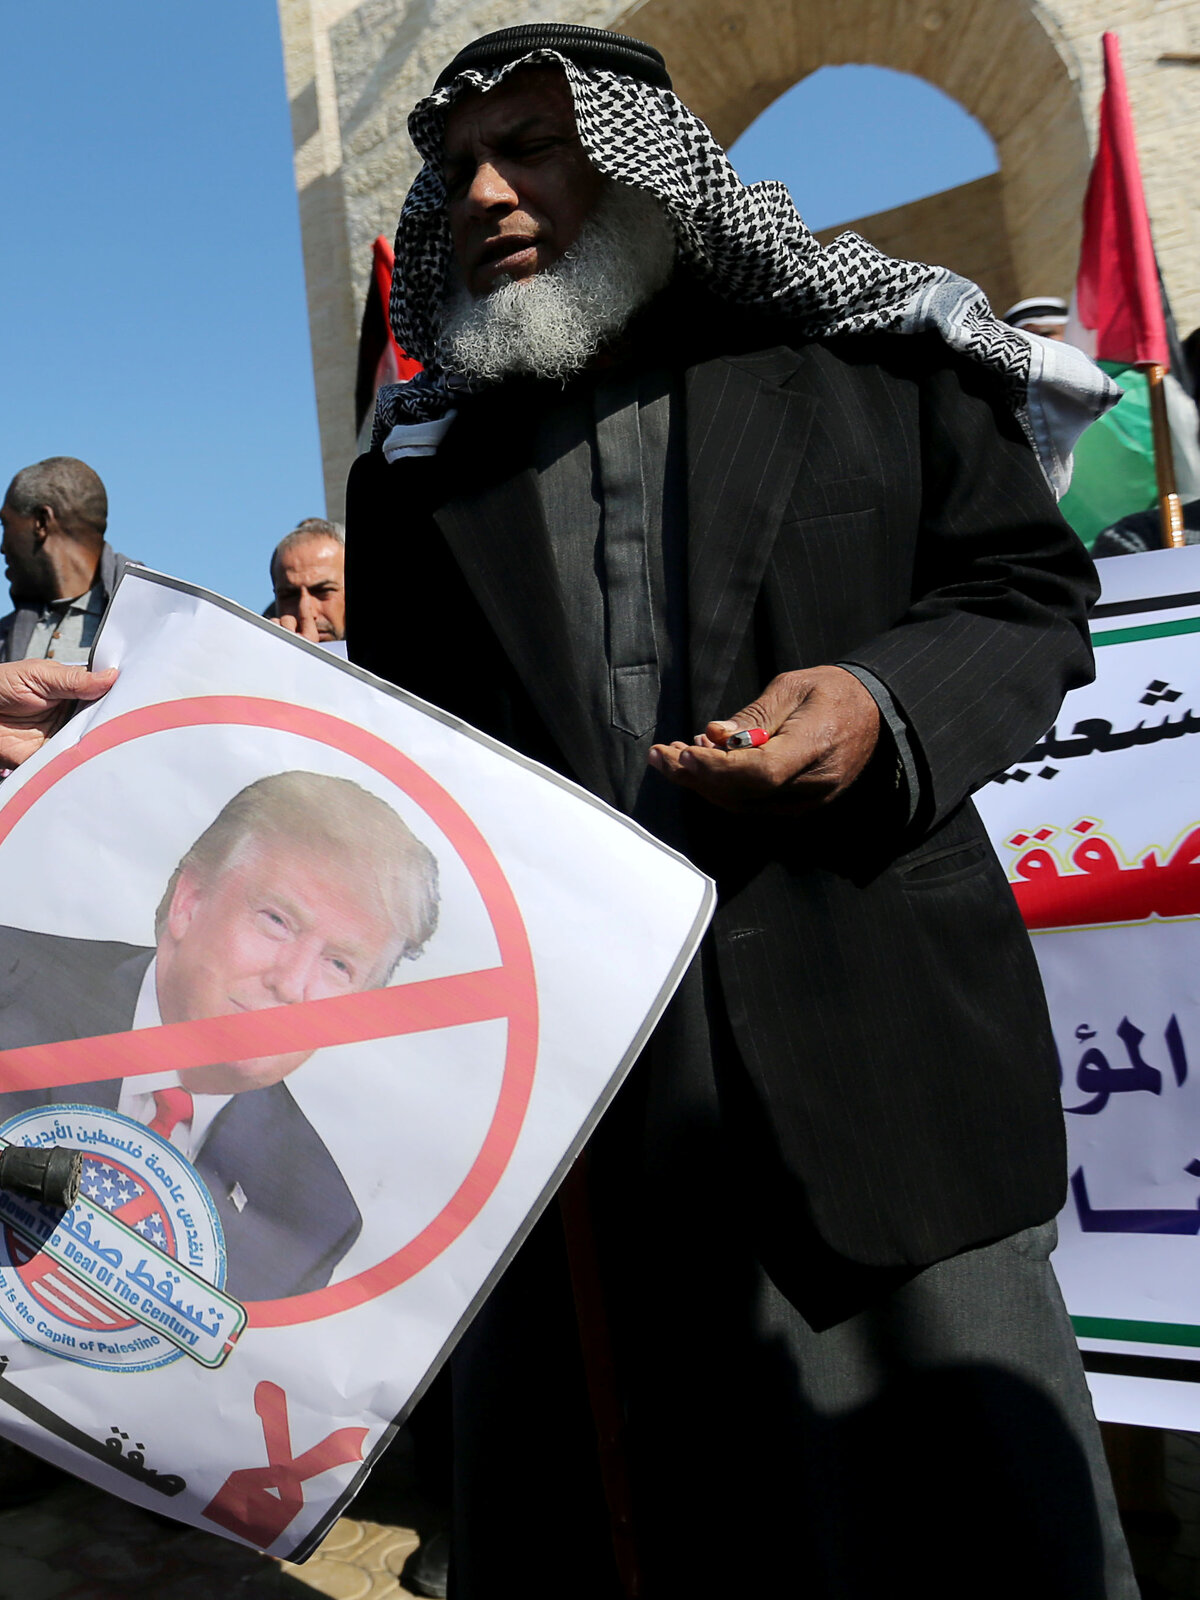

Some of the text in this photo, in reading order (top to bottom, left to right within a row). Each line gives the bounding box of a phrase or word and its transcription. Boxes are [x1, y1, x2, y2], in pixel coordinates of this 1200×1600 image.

[76, 1126, 143, 1160] فلسطين
[144, 1153, 185, 1204] عاصمة
[176, 1207, 204, 1268] القدس
[36, 1218, 61, 1247] The
[63, 1240, 99, 1275] Deal
[96, 1266, 114, 1287] Of
[113, 1277, 141, 1306] The
[139, 1297, 201, 1347] Century
[126, 1259, 224, 1338] تسقط
[5, 1287, 18, 1303] is
[15, 1301, 36, 1325] the
[36, 1321, 76, 1348] Capitl
[79, 1339, 95, 1352] of
[97, 1334, 161, 1355] Palestine
[200, 1380, 371, 1549] لا
